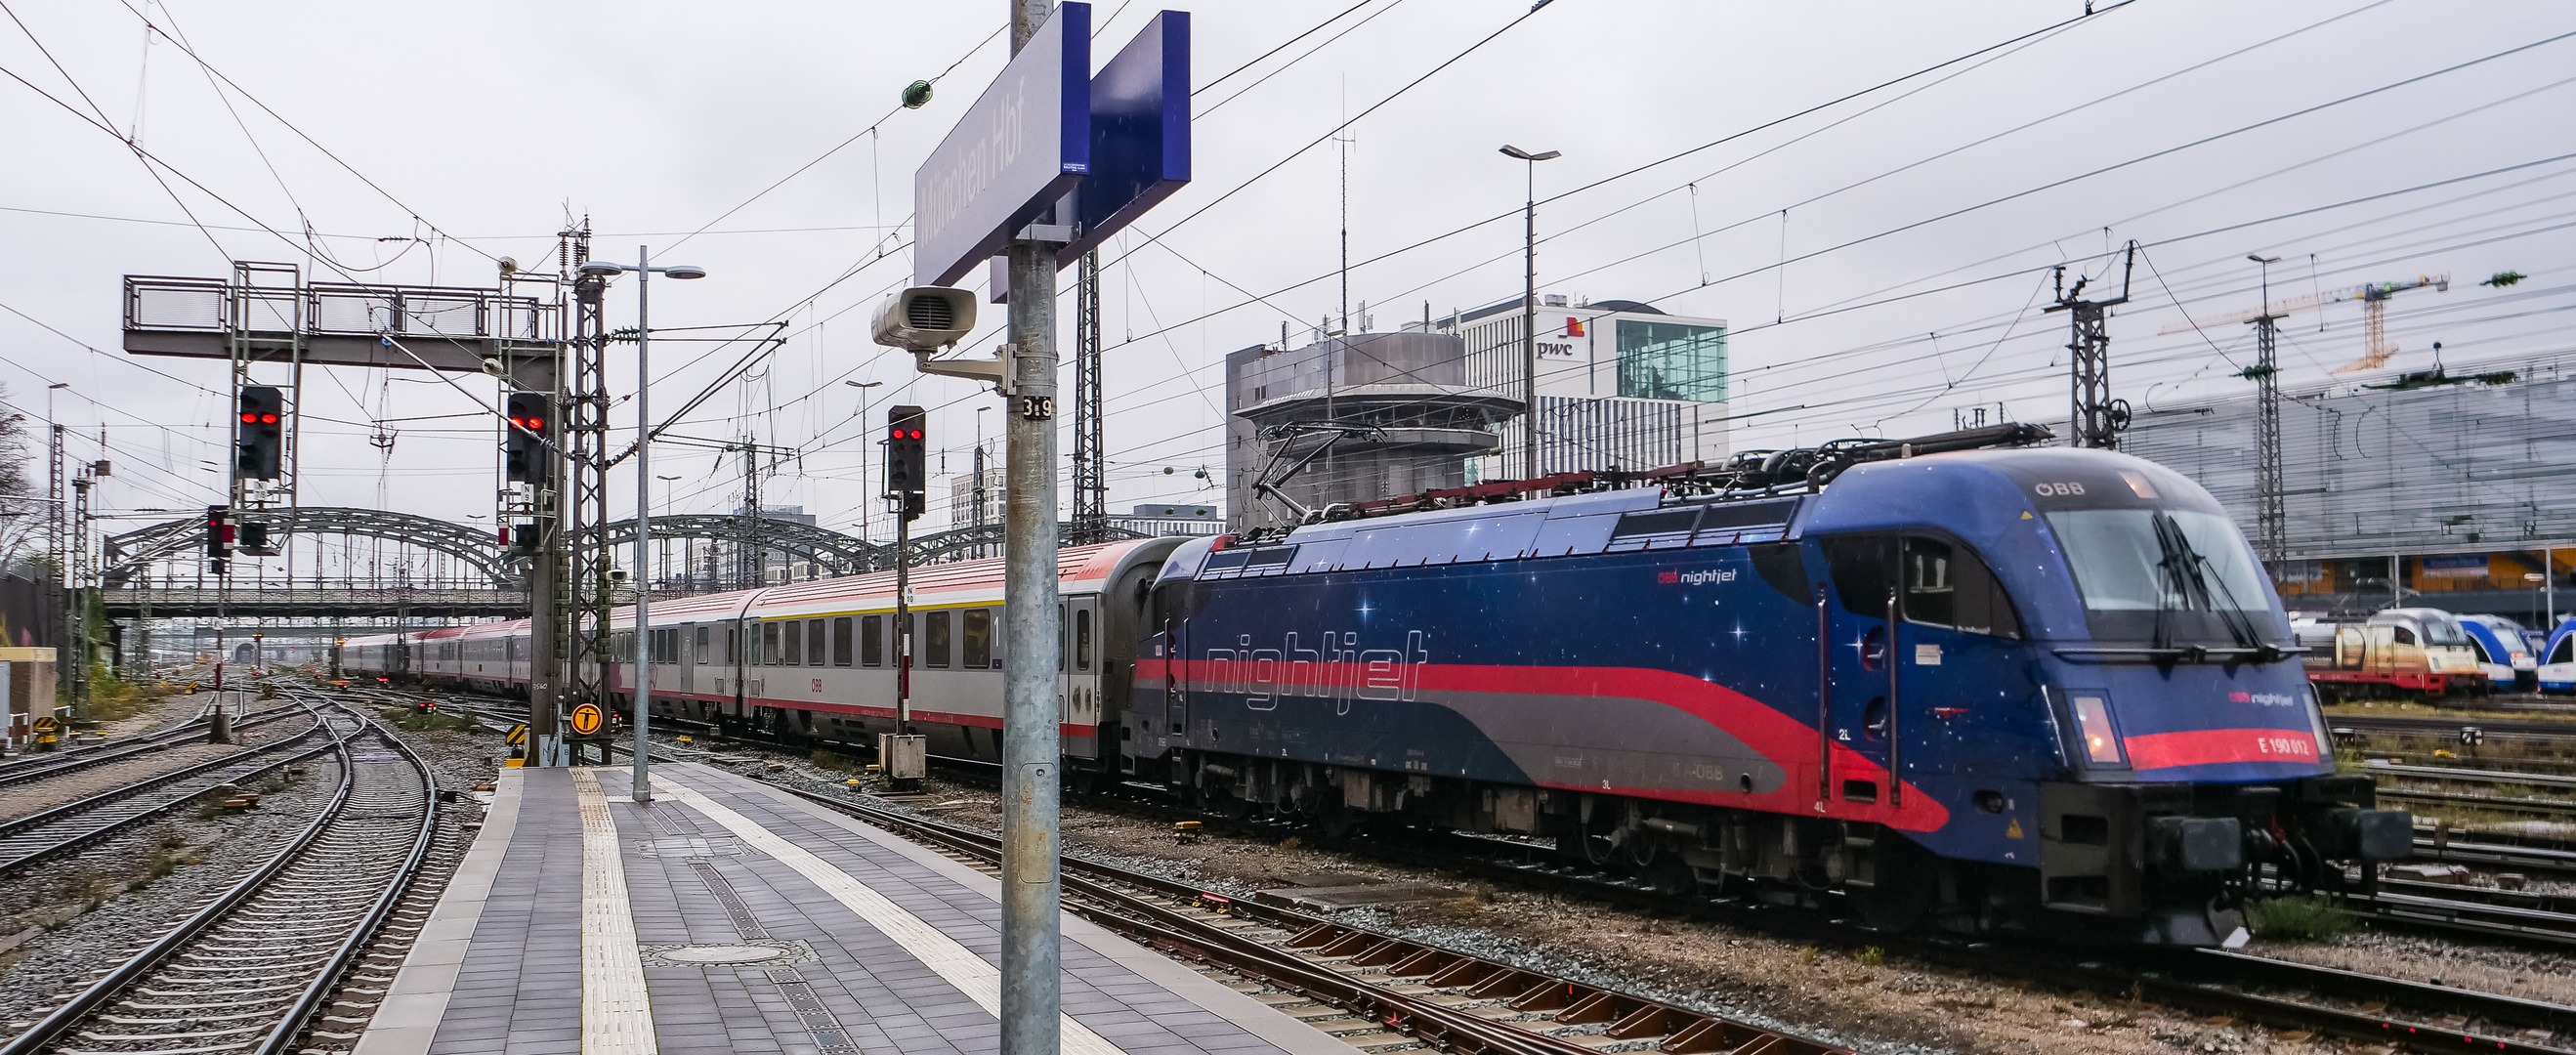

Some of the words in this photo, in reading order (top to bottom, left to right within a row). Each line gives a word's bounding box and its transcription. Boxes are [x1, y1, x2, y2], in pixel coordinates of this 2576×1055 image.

[921, 138, 987, 249] München
[992, 75, 1025, 181] Hbf
[1536, 342, 1573, 359] pwc
[1680, 569, 1738, 586] nightjet
[993, 615, 999, 648] 1
[1204, 630, 1428, 715] nightjet
[1838, 728, 1851, 741] 2L
[2258, 737, 2268, 754] E
[2269, 738, 2291, 754] 190
[1602, 779, 1612, 790] 3L
[1814, 801, 1826, 813] 4L
